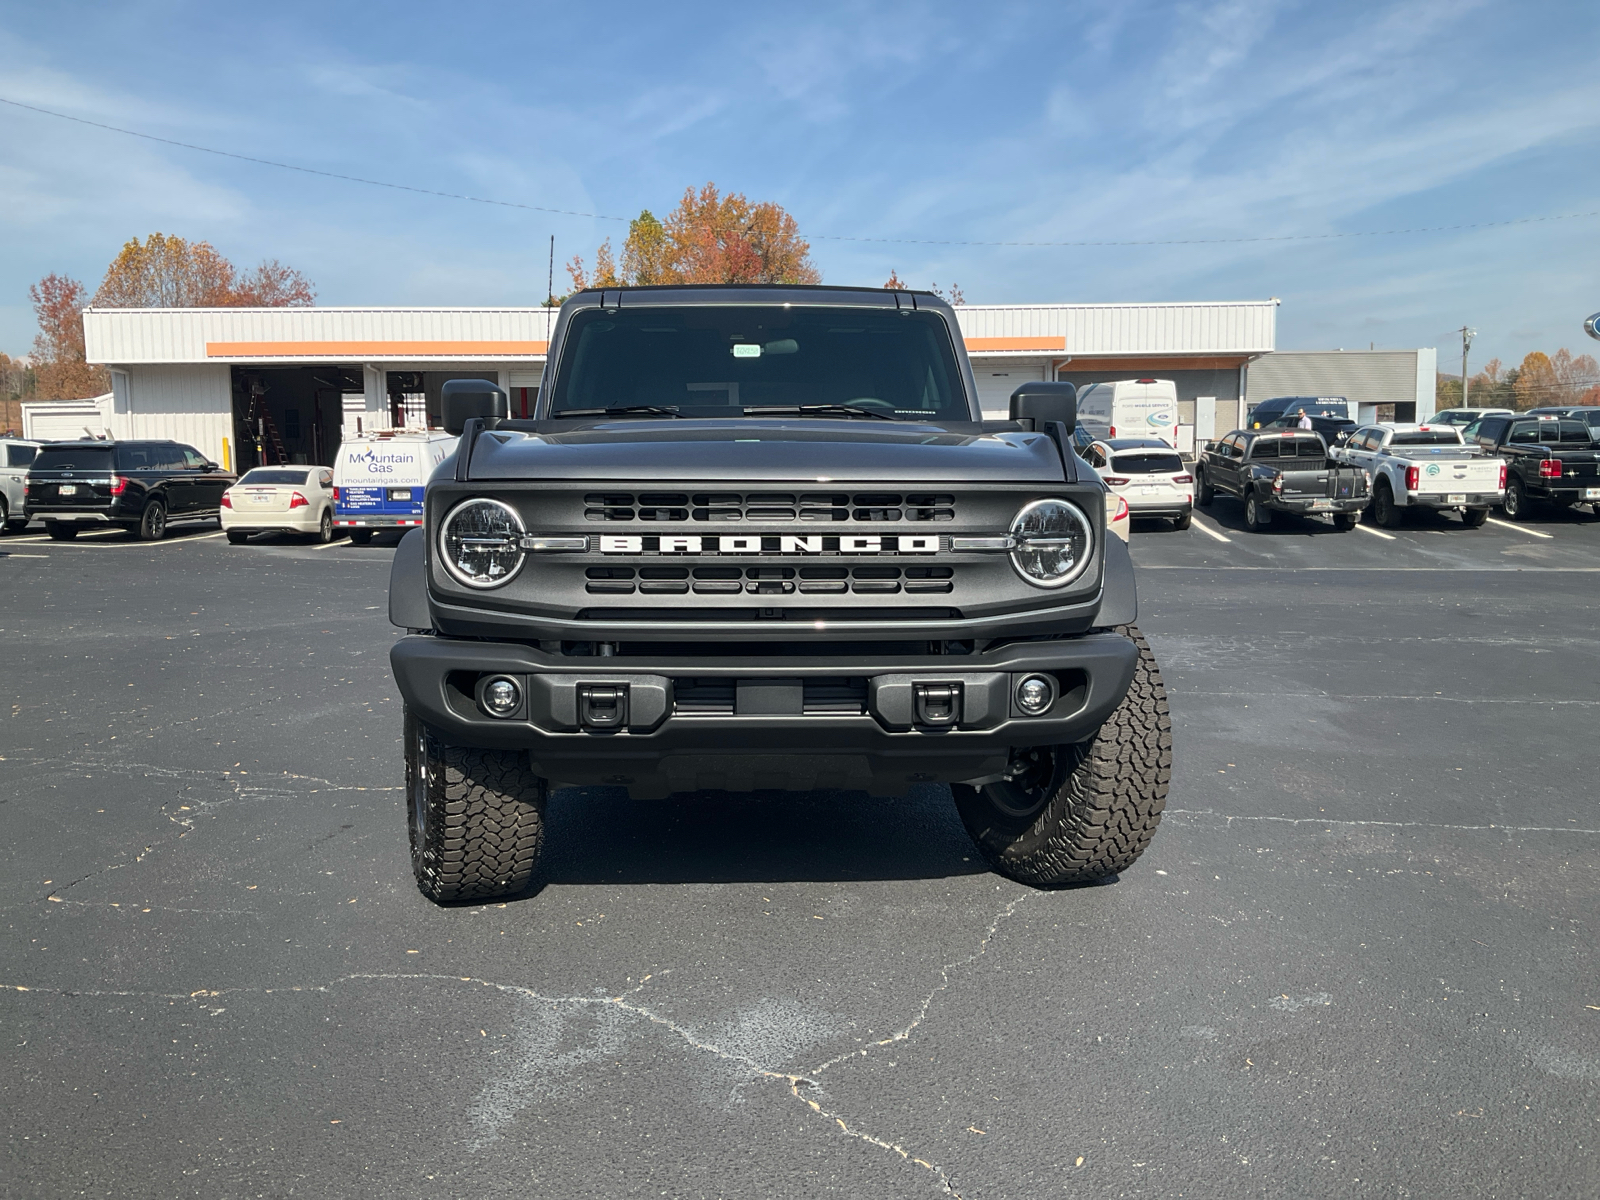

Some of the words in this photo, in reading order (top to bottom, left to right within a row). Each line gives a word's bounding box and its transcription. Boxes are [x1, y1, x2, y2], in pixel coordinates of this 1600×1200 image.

[349, 451, 414, 463] Mountain
[368, 463, 393, 473] Gas
[600, 536, 939, 552] BRONCO
